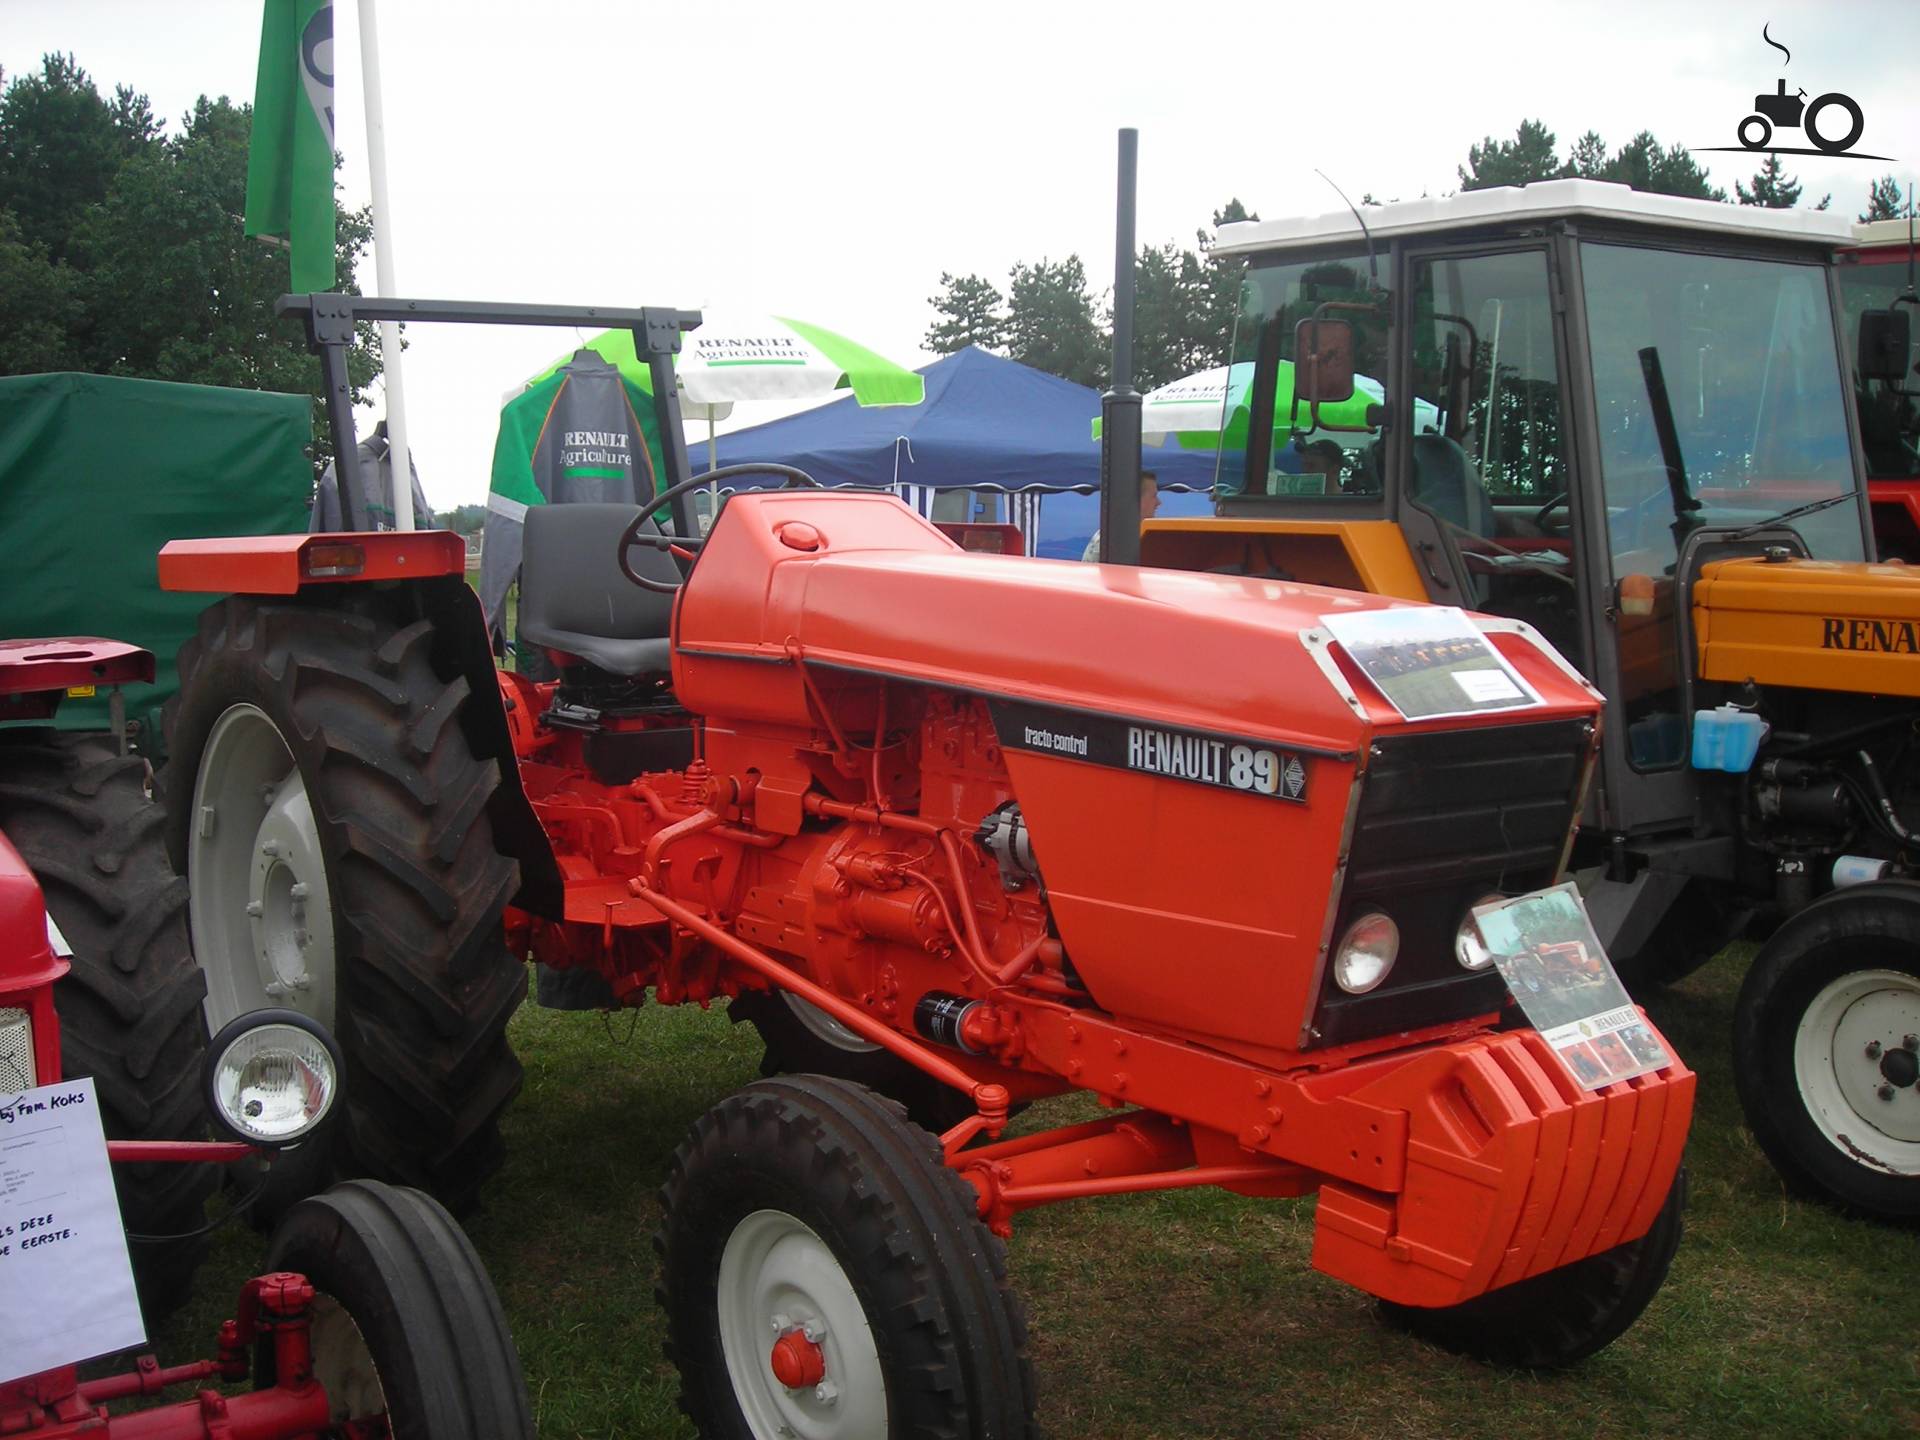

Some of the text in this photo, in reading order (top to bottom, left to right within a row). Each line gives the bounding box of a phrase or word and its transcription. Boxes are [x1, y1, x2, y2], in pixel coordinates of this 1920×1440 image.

[698, 338, 794, 347] RENAULT
[693, 348, 808, 360] Agriculture
[564, 431, 629, 447] RENAULT
[560, 448, 632, 466] Agriculture
[1821, 617, 1920, 654] RENA
[1128, 727, 1279, 794] RENAULT 89
[20, 1214, 53, 1232] DEZE
